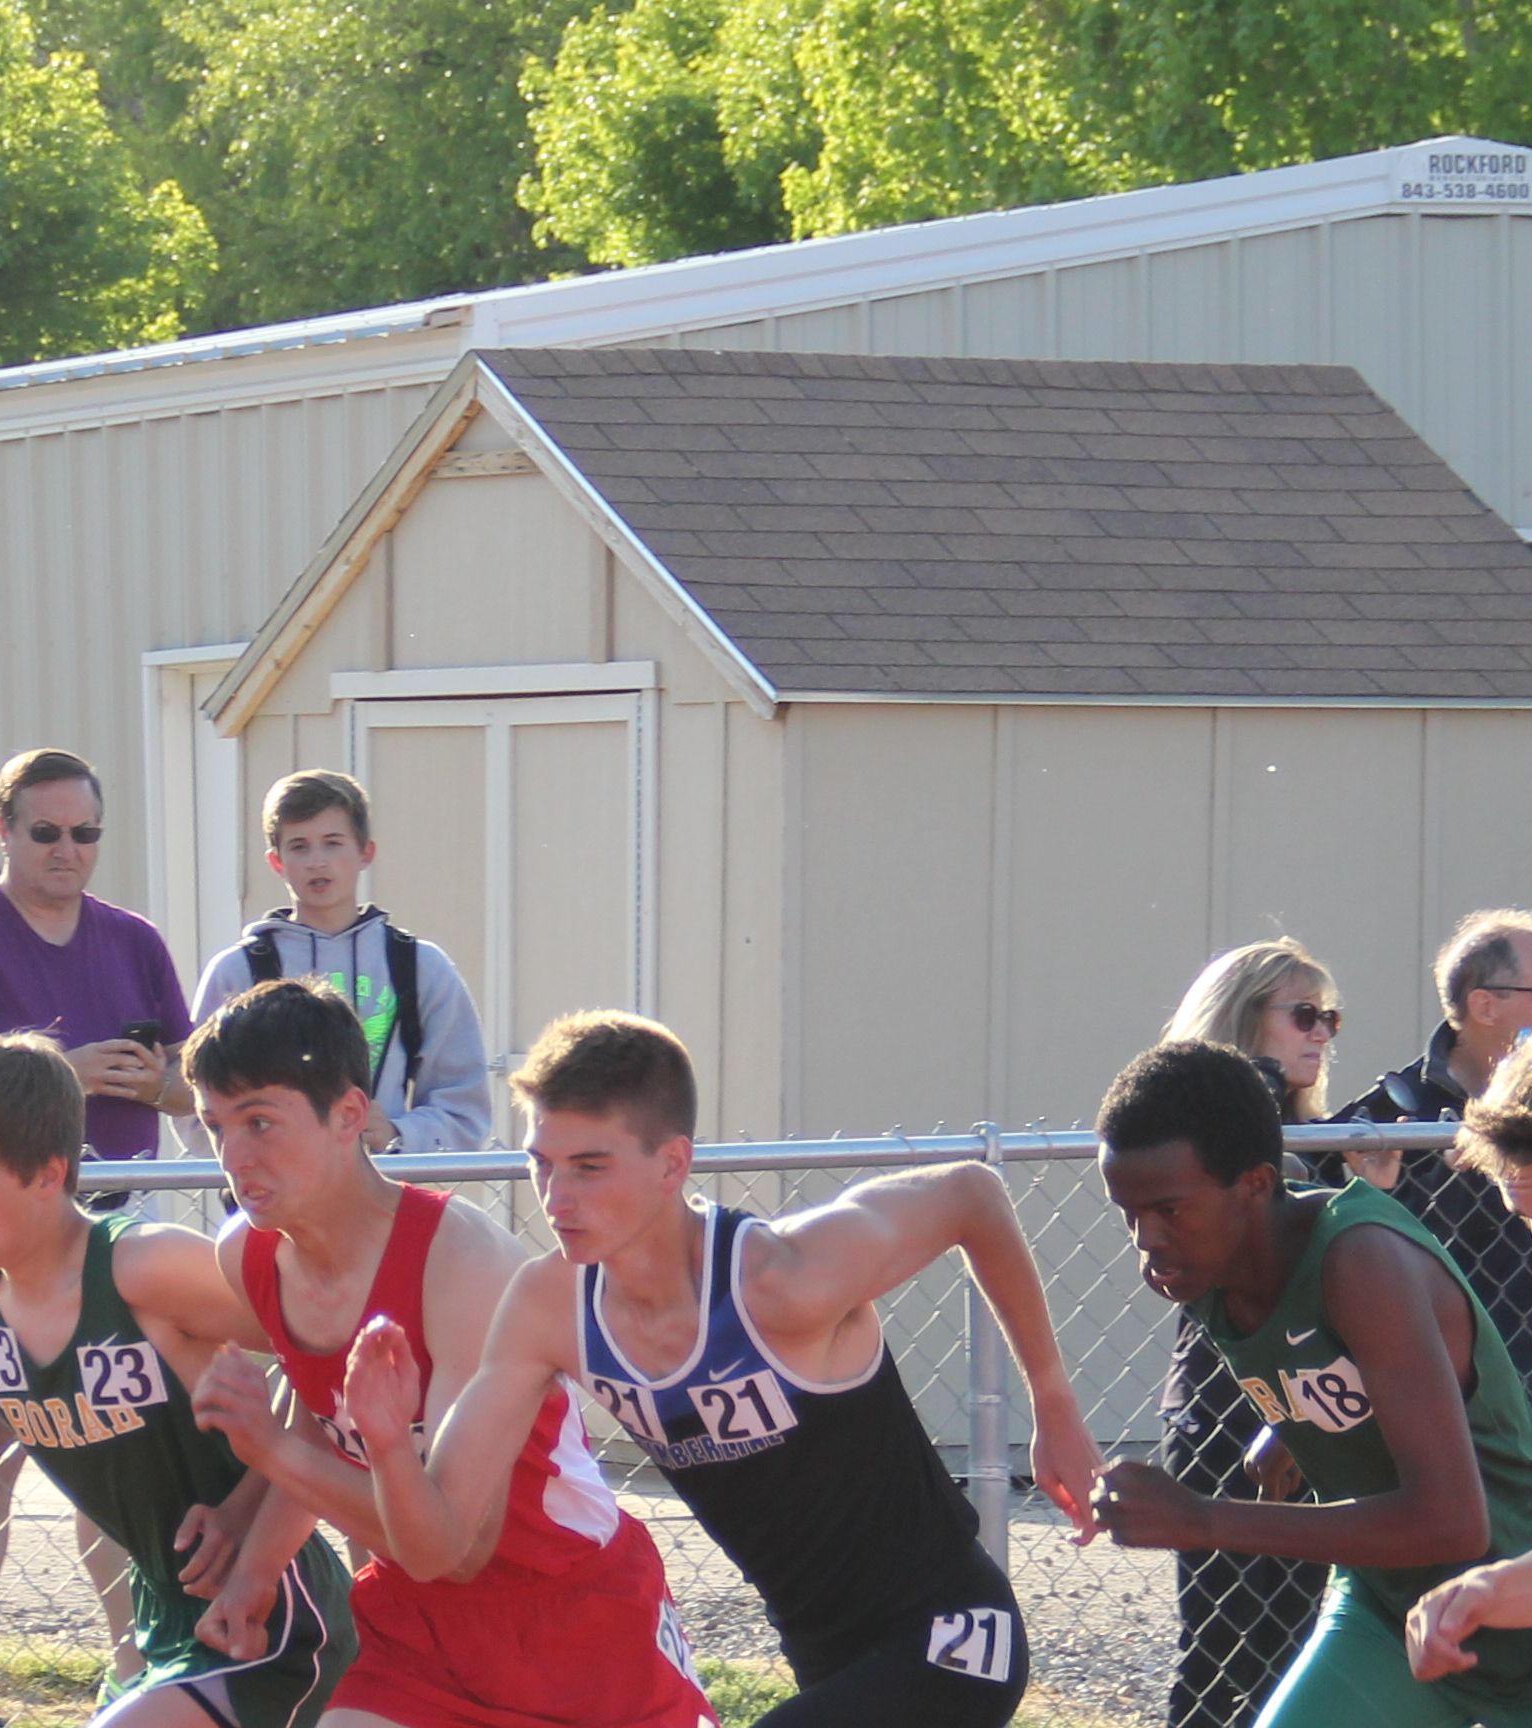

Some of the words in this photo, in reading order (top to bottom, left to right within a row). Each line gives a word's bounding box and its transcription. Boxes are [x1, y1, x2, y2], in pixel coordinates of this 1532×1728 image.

[1401, 183, 1530, 199] 843-538-4600
[1429, 154, 1527, 174] ROCKFORD
[84, 1348, 152, 1406] 23
[1302, 1373, 1370, 1428] 18
[594, 1379, 654, 1438] 21
[701, 1378, 777, 1441] 21
[935, 1612, 996, 1675] 21
